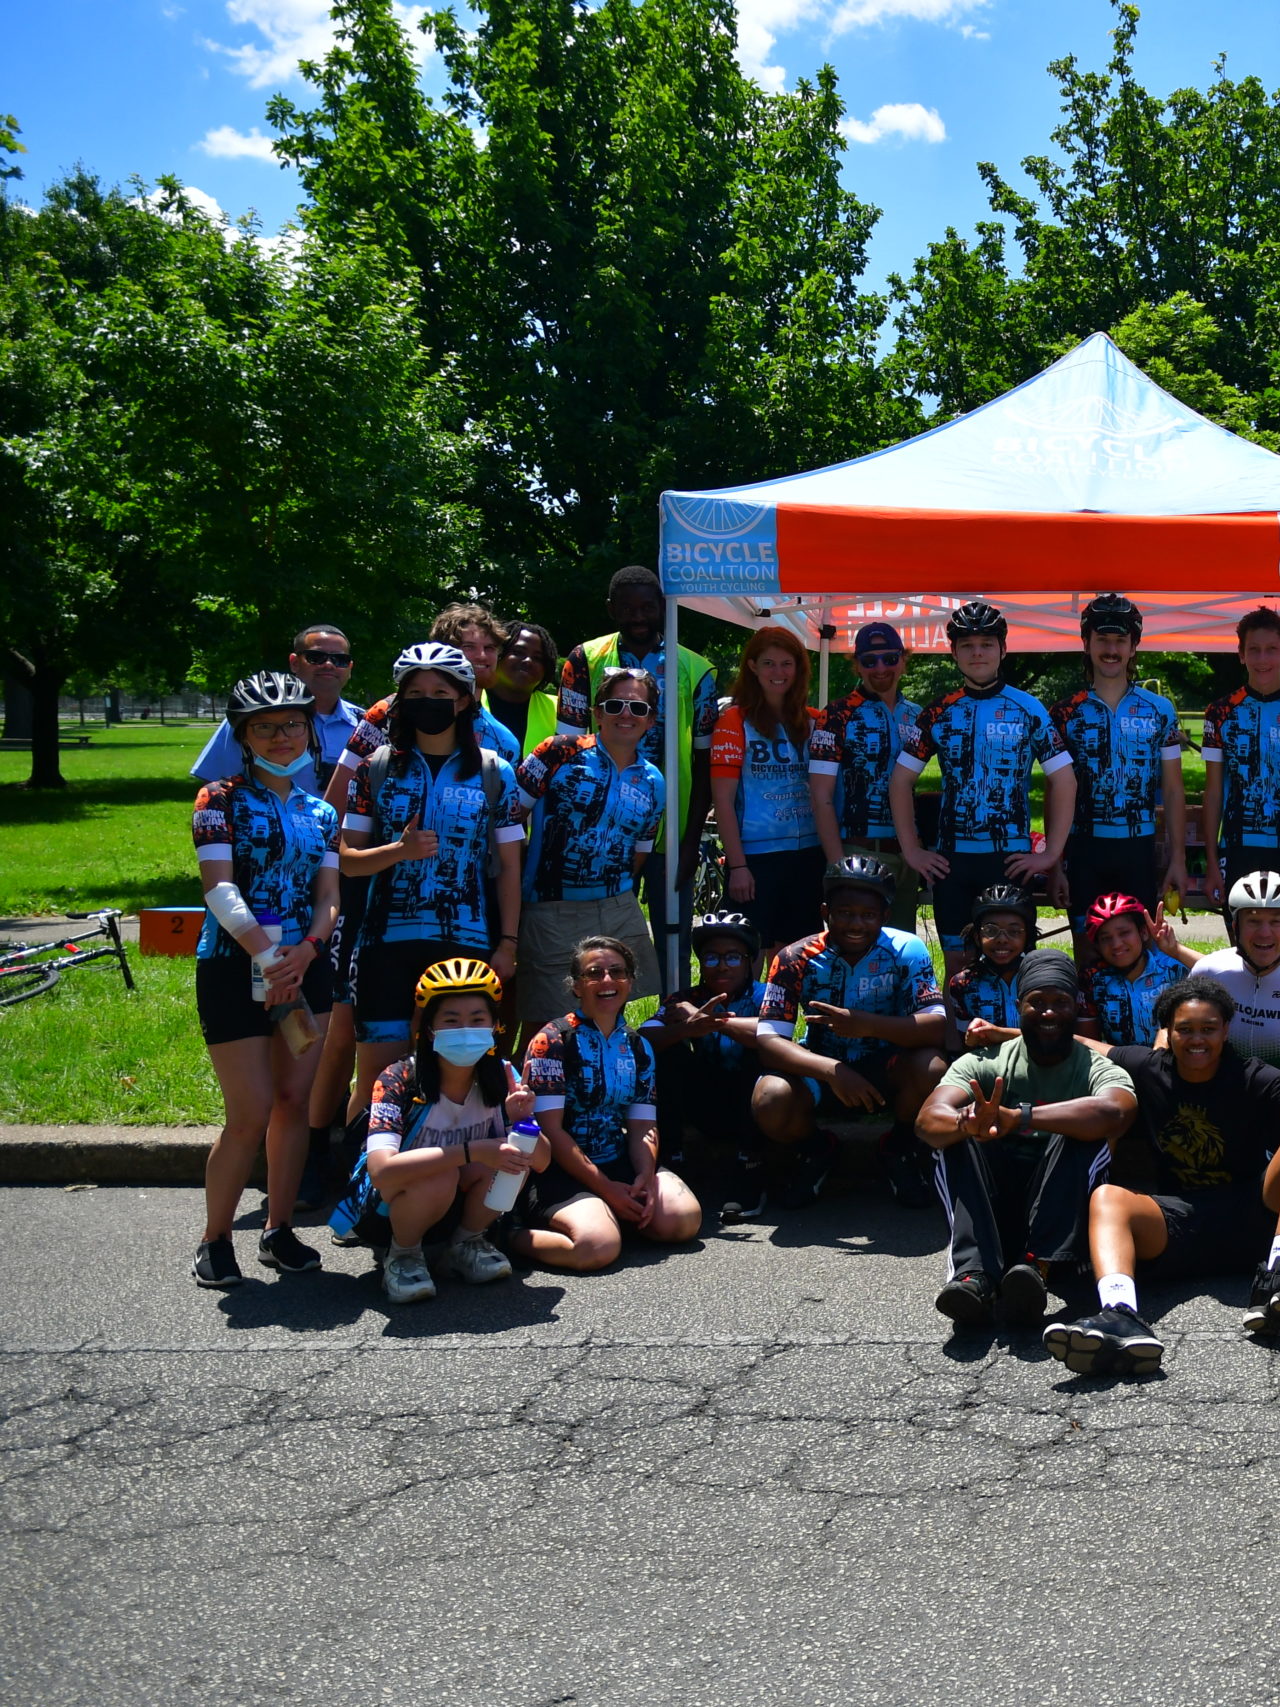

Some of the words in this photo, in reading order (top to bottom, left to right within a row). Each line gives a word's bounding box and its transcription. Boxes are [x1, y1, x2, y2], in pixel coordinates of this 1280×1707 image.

[667, 542, 774, 563] BICYCLE
[668, 564, 774, 581] COALITION
[680, 583, 717, 593] YOUTH
[720, 582, 765, 592] CYCLING
[1121, 716, 1157, 729] BCYC
[986, 723, 1024, 736] BCYC
[170, 916, 184, 934] 2
[1241, 1018, 1264, 1027] RACING
